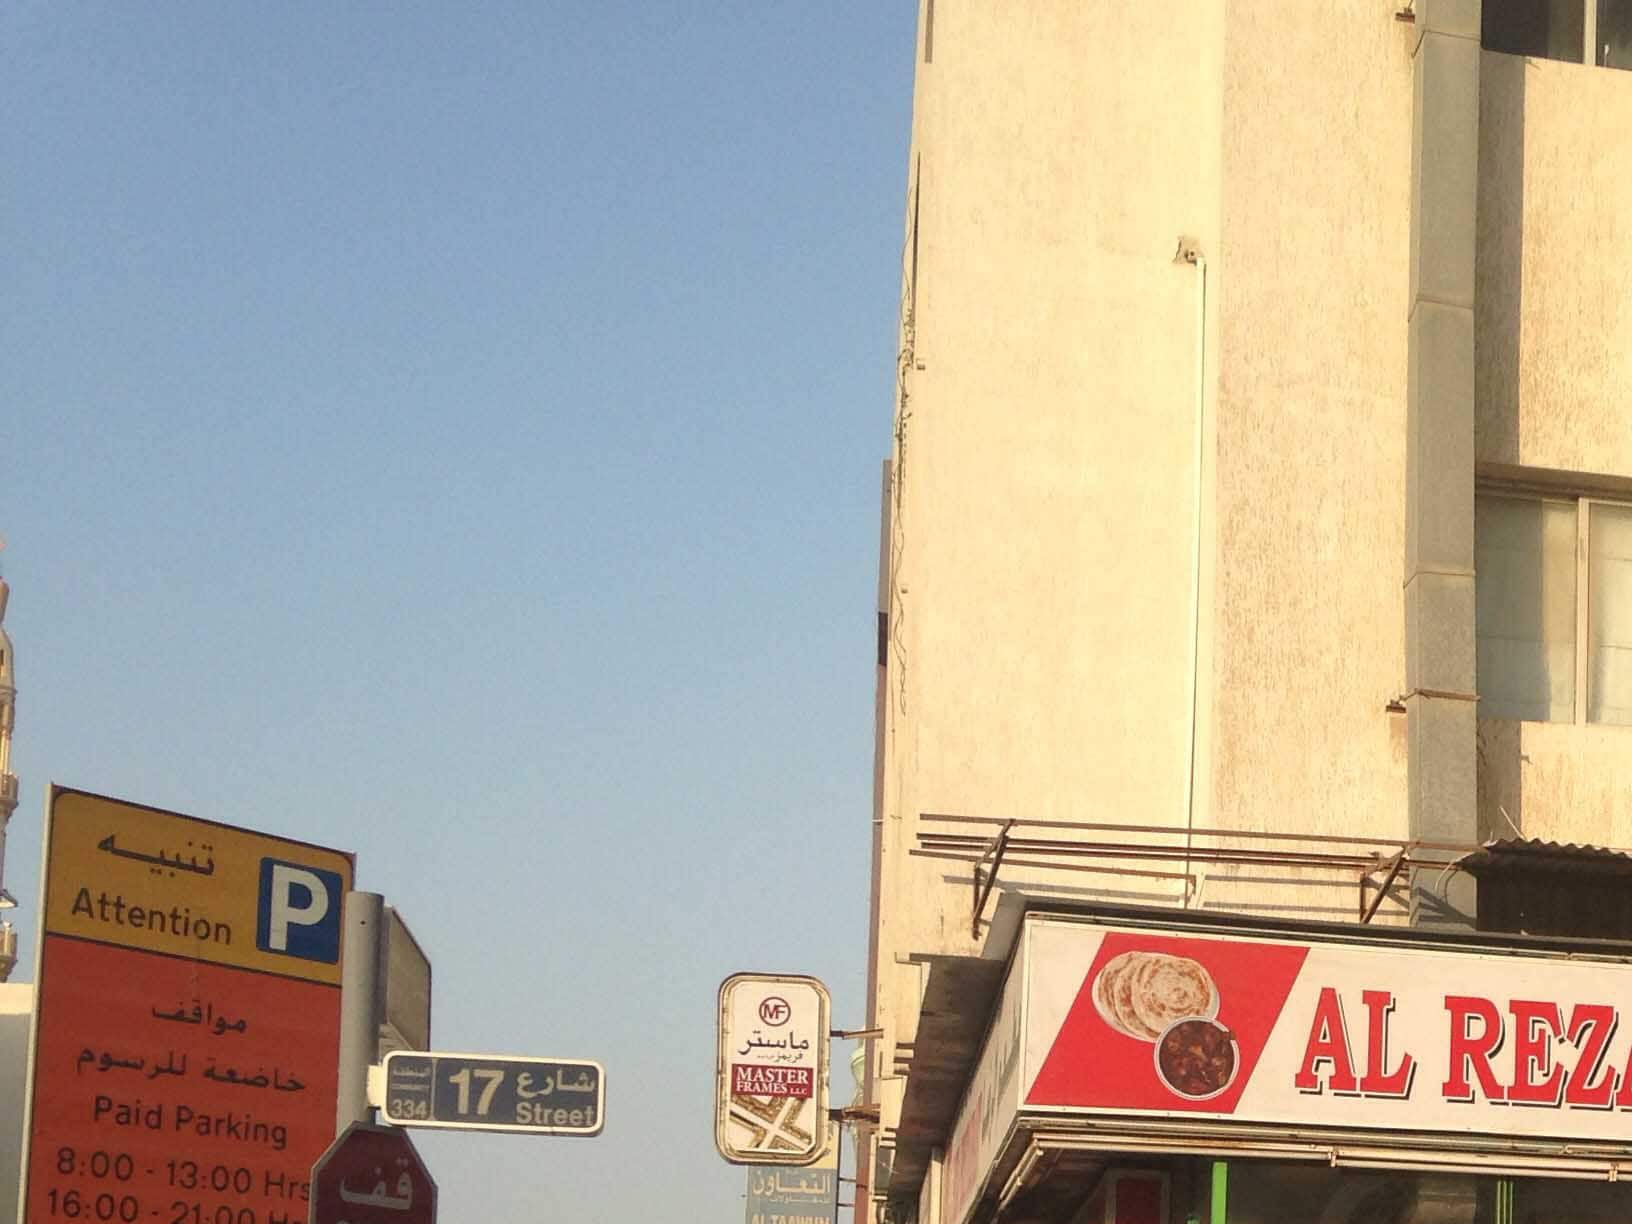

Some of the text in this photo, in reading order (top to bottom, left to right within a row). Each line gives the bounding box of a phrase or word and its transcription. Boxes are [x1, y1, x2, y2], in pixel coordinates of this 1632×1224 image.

[97, 833, 215, 878] تنبيه
[71, 887, 232, 946] Attention
[268, 863, 330, 952] P
[151, 1000, 247, 1036] مواقف
[738, 1029, 809, 1055] ماستر
[1294, 987, 1418, 1101] AL
[76, 1048, 306, 1093] خاضعة للرسوم
[515, 1069, 597, 1099] شارع
[736, 1066, 809, 1085] MASTER
[736, 1081, 788, 1095] FRAMES
[391, 1099, 428, 1120] 334
[449, 1068, 505, 1116] 17
[94, 1096, 288, 1151] Paid Parking
[516, 1102, 595, 1126] Street
[56, 1146, 134, 1181] 8:00
[166, 1160, 252, 1194] 13:00
[264, 1171, 311, 1201] Hrs
[339, 1158, 413, 1211] قف
[752, 1169, 831, 1196] التعاون
[47, 1189, 139, 1223] 16:00
